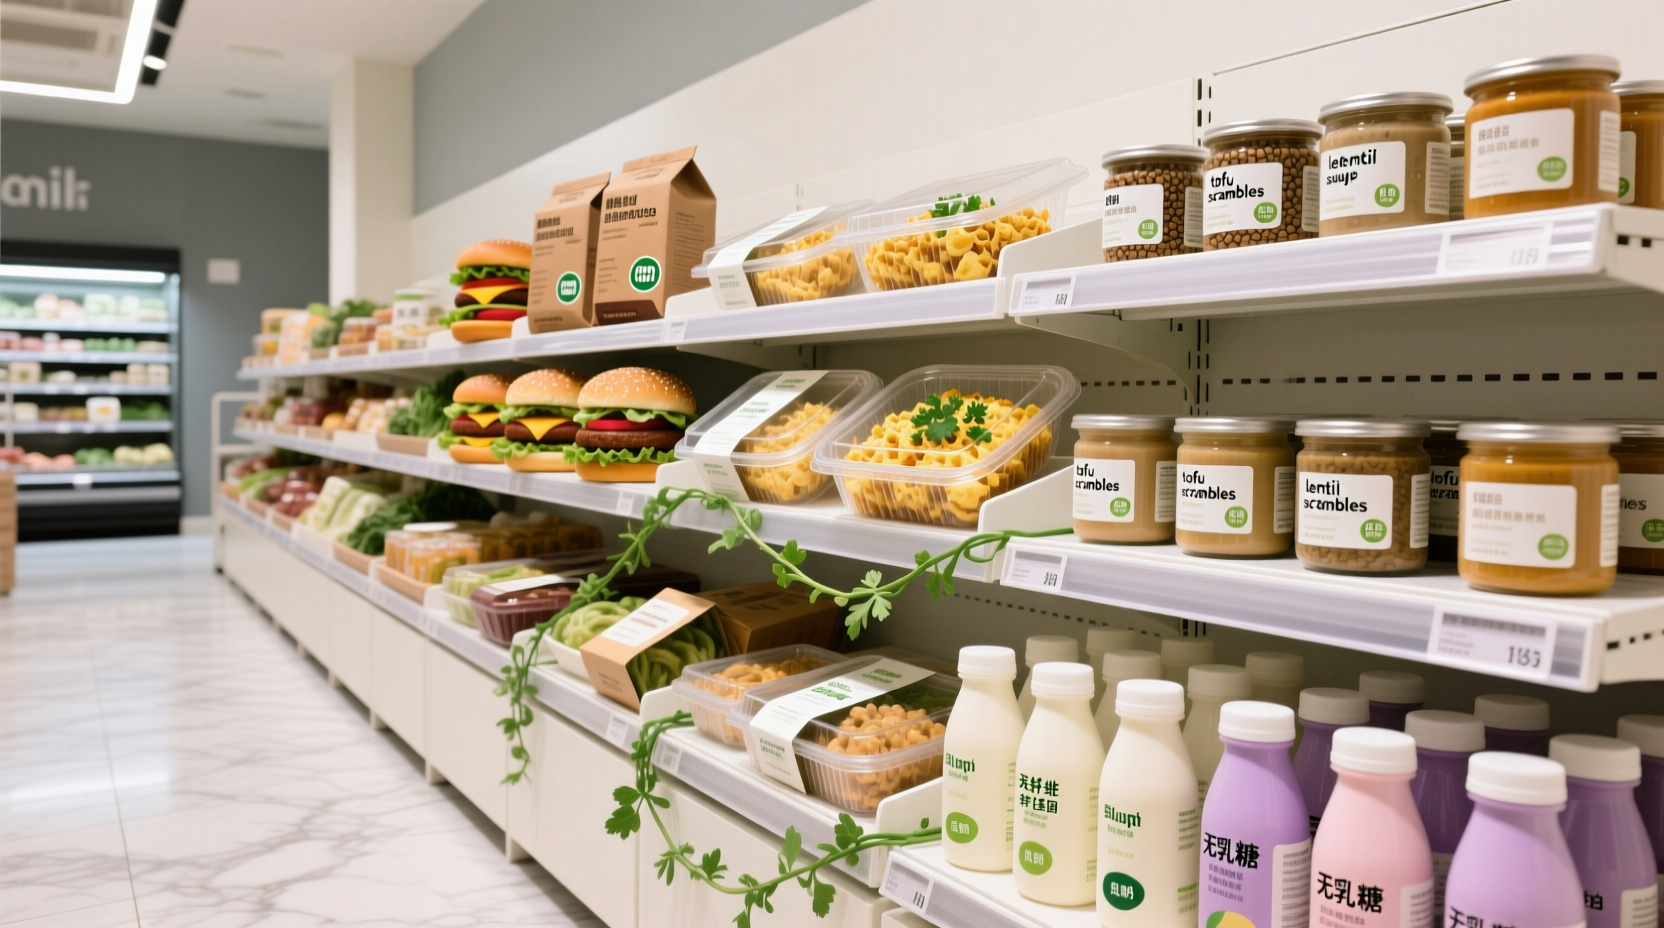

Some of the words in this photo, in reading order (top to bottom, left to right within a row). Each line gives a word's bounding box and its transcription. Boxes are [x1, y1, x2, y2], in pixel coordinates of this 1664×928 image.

[1203, 831, 1260, 870] 无乳糖
[1317, 870, 1384, 914] 无乳糖
